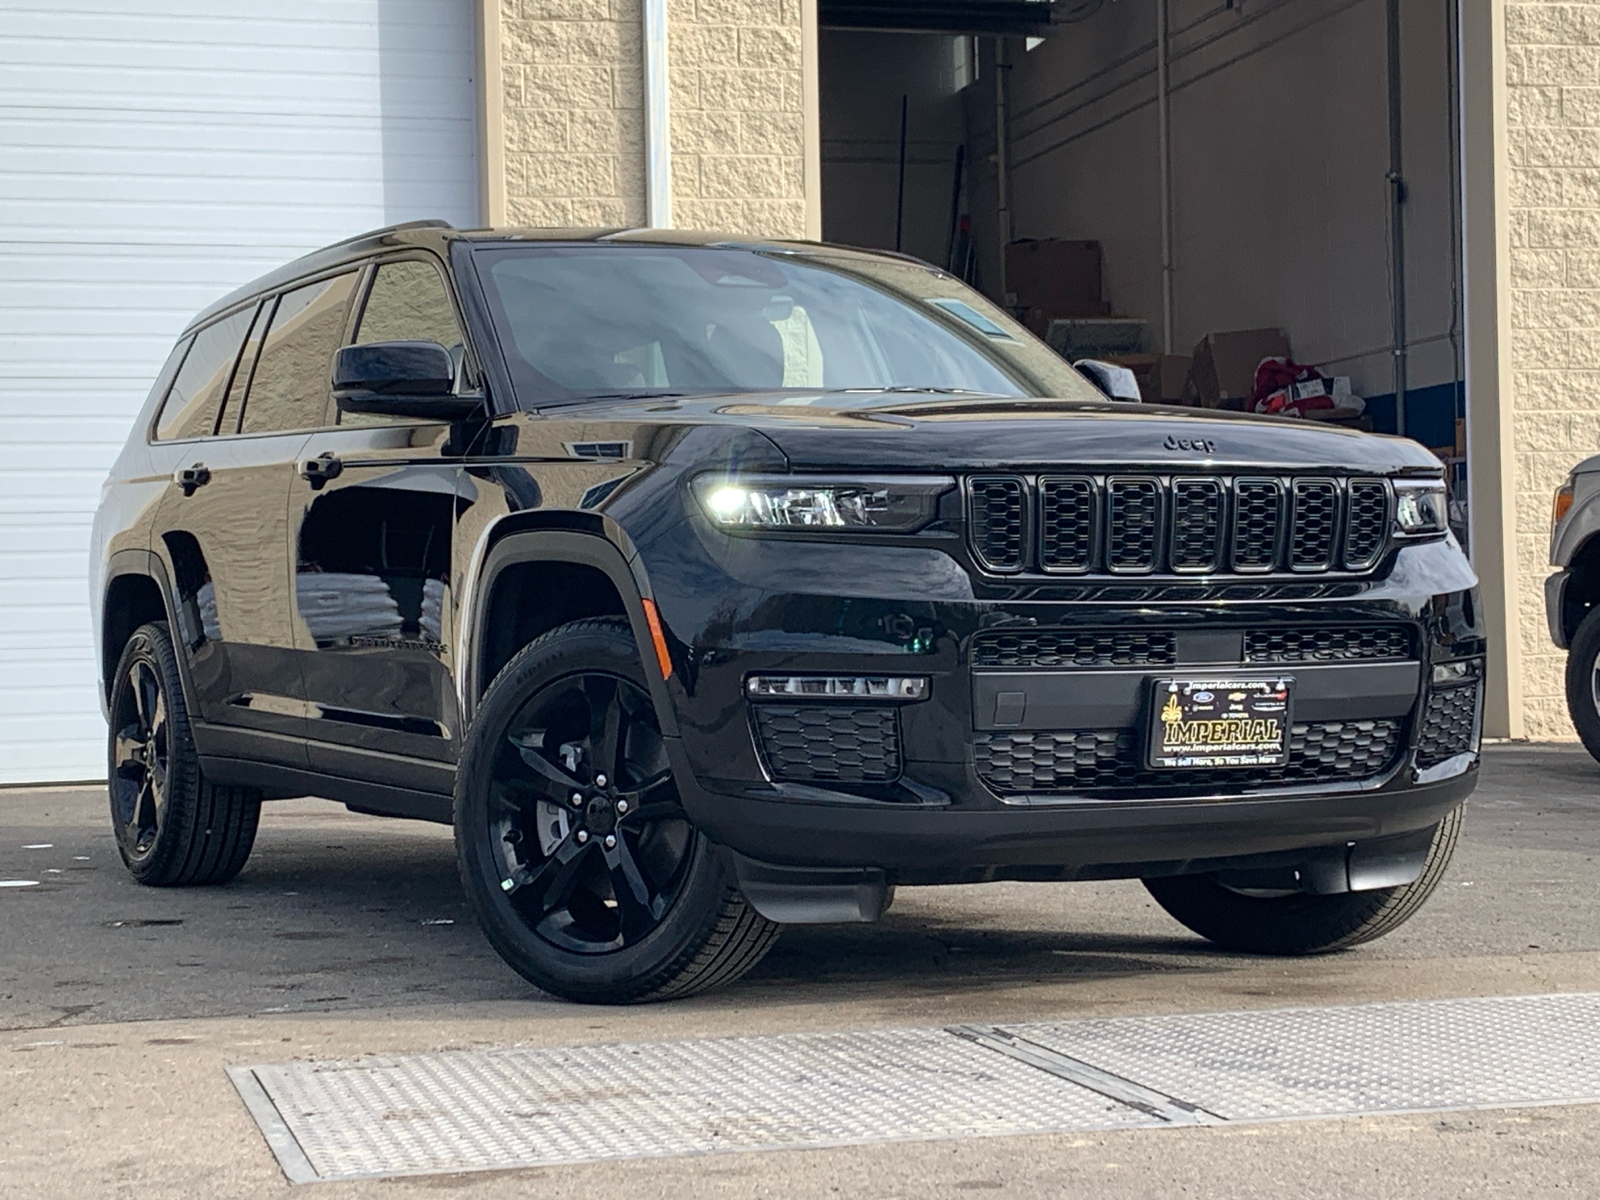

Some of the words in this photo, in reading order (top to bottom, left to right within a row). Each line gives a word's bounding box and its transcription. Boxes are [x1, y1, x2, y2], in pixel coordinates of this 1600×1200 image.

[1163, 435, 1216, 453] Jeep
[1164, 719, 1282, 744] IMPERIAL
[1163, 743, 1281, 752] www.imperialcars.com
[1164, 758, 1176, 767] We
[1178, 758, 1191, 767] Sell
[1193, 758, 1213, 767] More,
[1215, 757, 1224, 765] So
[1226, 757, 1239, 765] You
[1240, 756, 1257, 765] Save
[1259, 756, 1276, 764] More
